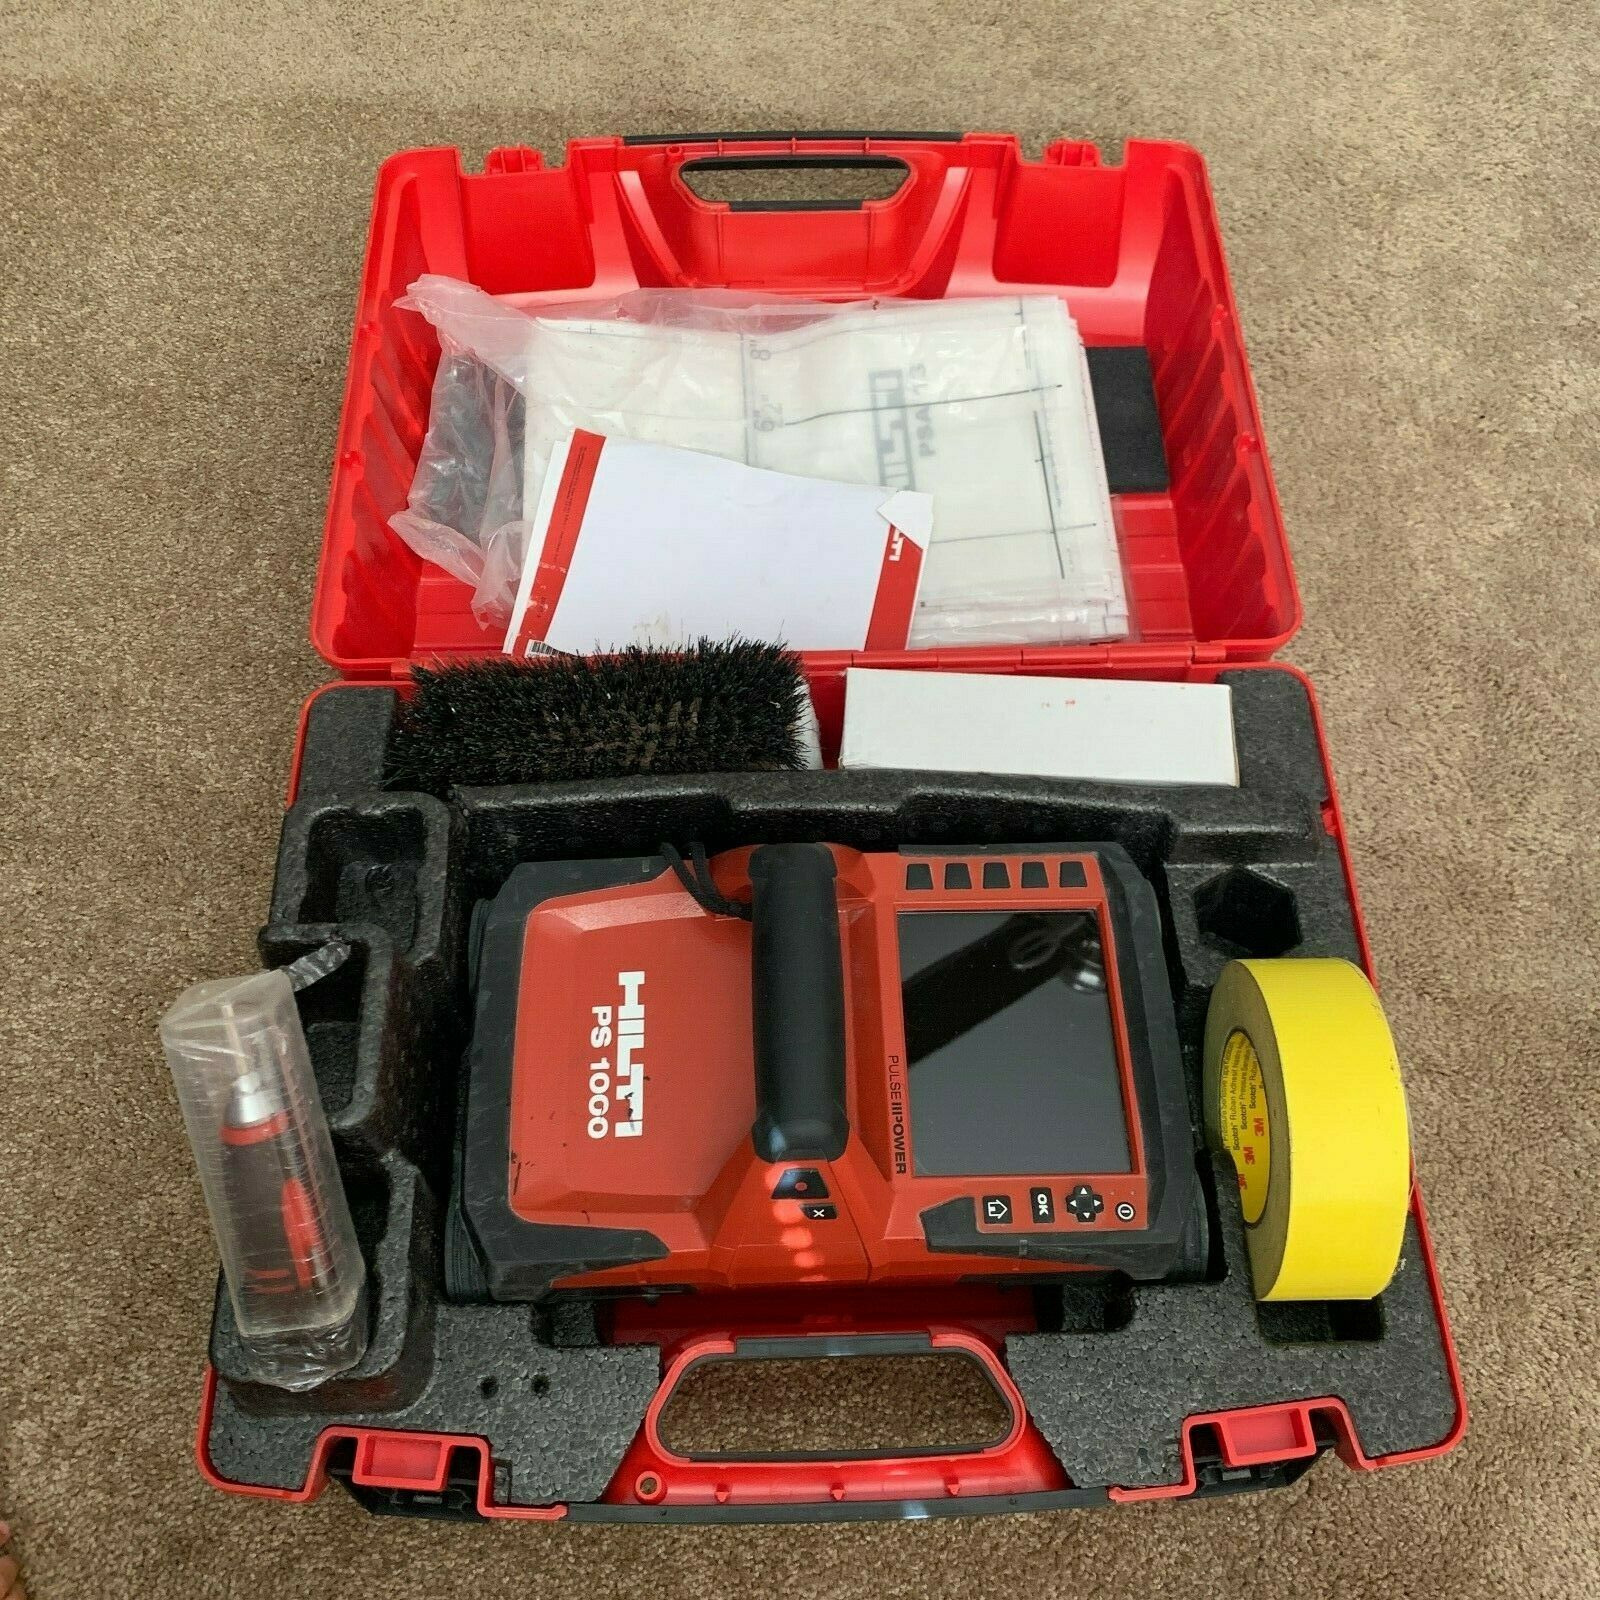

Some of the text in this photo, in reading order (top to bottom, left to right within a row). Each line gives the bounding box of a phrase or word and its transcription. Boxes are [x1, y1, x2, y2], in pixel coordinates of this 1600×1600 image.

[615, 970, 646, 1138] HILTI
[587, 1005, 613, 1139] PS 1000
[888, 1055, 902, 1100] PULSE
[1248, 1084, 1257, 1109] Scotch
[1239, 1104, 1248, 1130] Scotch
[1254, 1117, 1264, 1137] 3M
[1231, 1125, 1240, 1151] Scotch
[1243, 1146, 1255, 1165] 3M
[1238, 1173, 1247, 1191] 3M
[1037, 1193, 1049, 1216] OK
